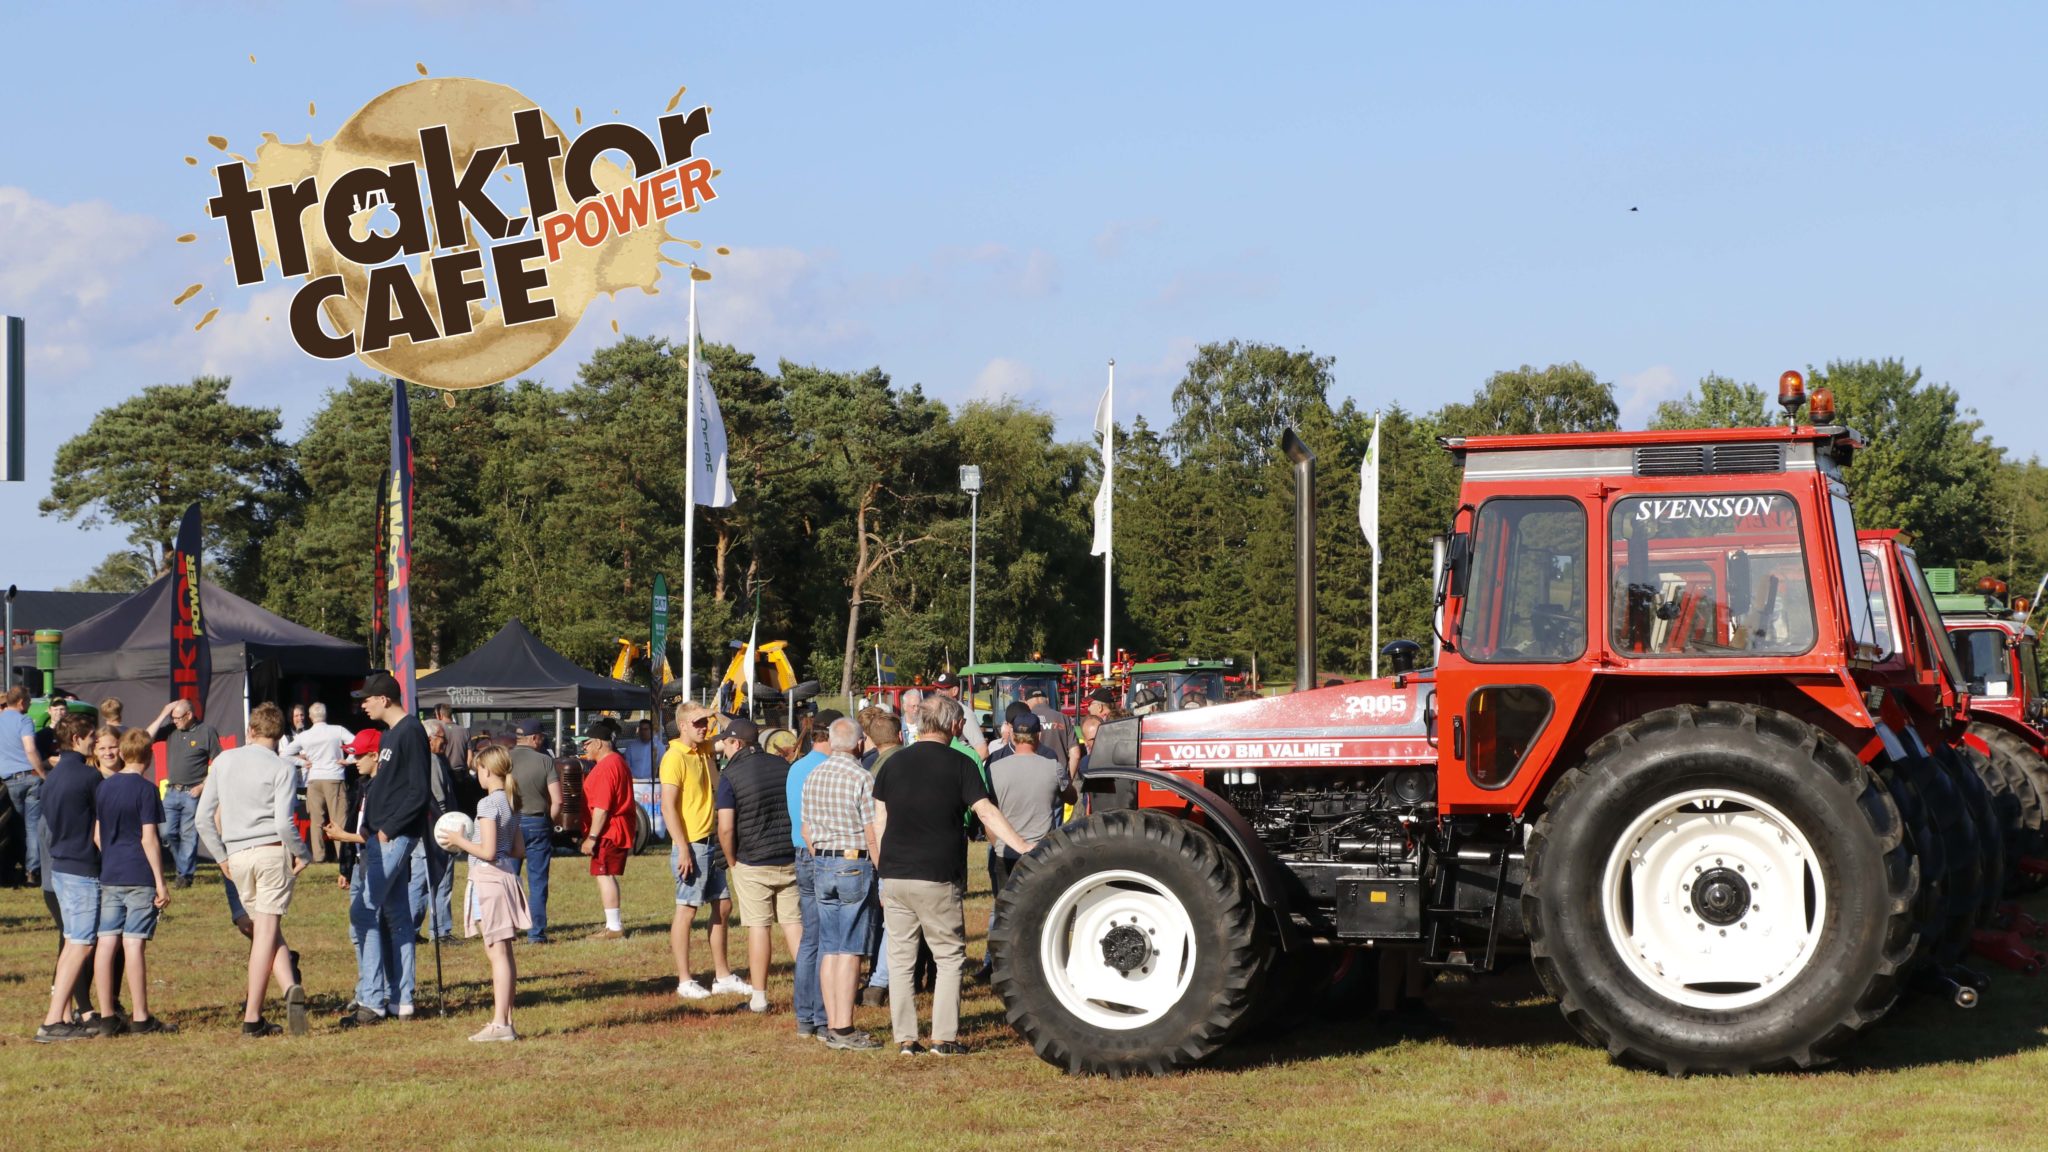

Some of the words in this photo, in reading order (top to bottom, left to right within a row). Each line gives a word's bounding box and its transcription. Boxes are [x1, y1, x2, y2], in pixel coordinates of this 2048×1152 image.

[1635, 496, 1775, 521] SVENSSON
[185, 553, 203, 636] POWER
[451, 695, 494, 705] WHEELS
[1345, 694, 1407, 714] 2005
[1169, 745, 1230, 759] VOLVO
[1236, 744, 1263, 759] BM
[1268, 743, 1343, 757] VALMET
